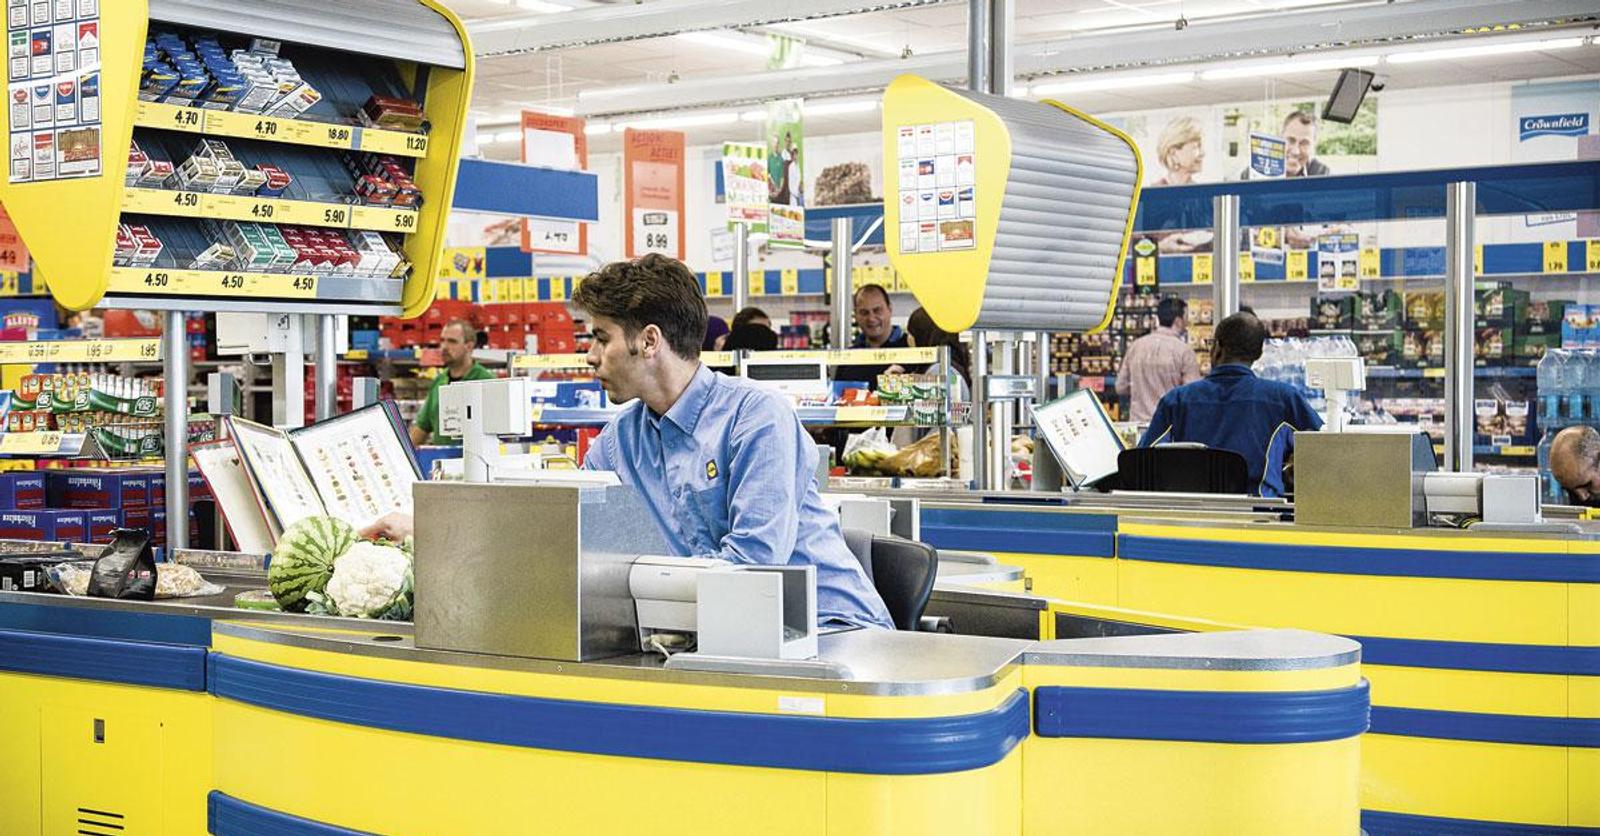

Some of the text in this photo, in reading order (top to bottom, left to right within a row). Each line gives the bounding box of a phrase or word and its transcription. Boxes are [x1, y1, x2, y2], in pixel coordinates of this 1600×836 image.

[175, 110, 199, 125] 4.70
[255, 121, 278, 135] 4.70
[328, 128, 350, 141] 18.80
[406, 136, 427, 151] 11.20
[174, 193, 198, 207] 4.50
[252, 204, 273, 218] 4.50
[324, 209, 345, 223] 5.90
[395, 214, 414, 228] 5.90
[646, 233, 668, 248] 8.99
[144, 273, 168, 287] 4.50
[221, 275, 244, 288] 4.50
[293, 277, 314, 290] 4.50
[140, 345, 156, 357] 1.95
